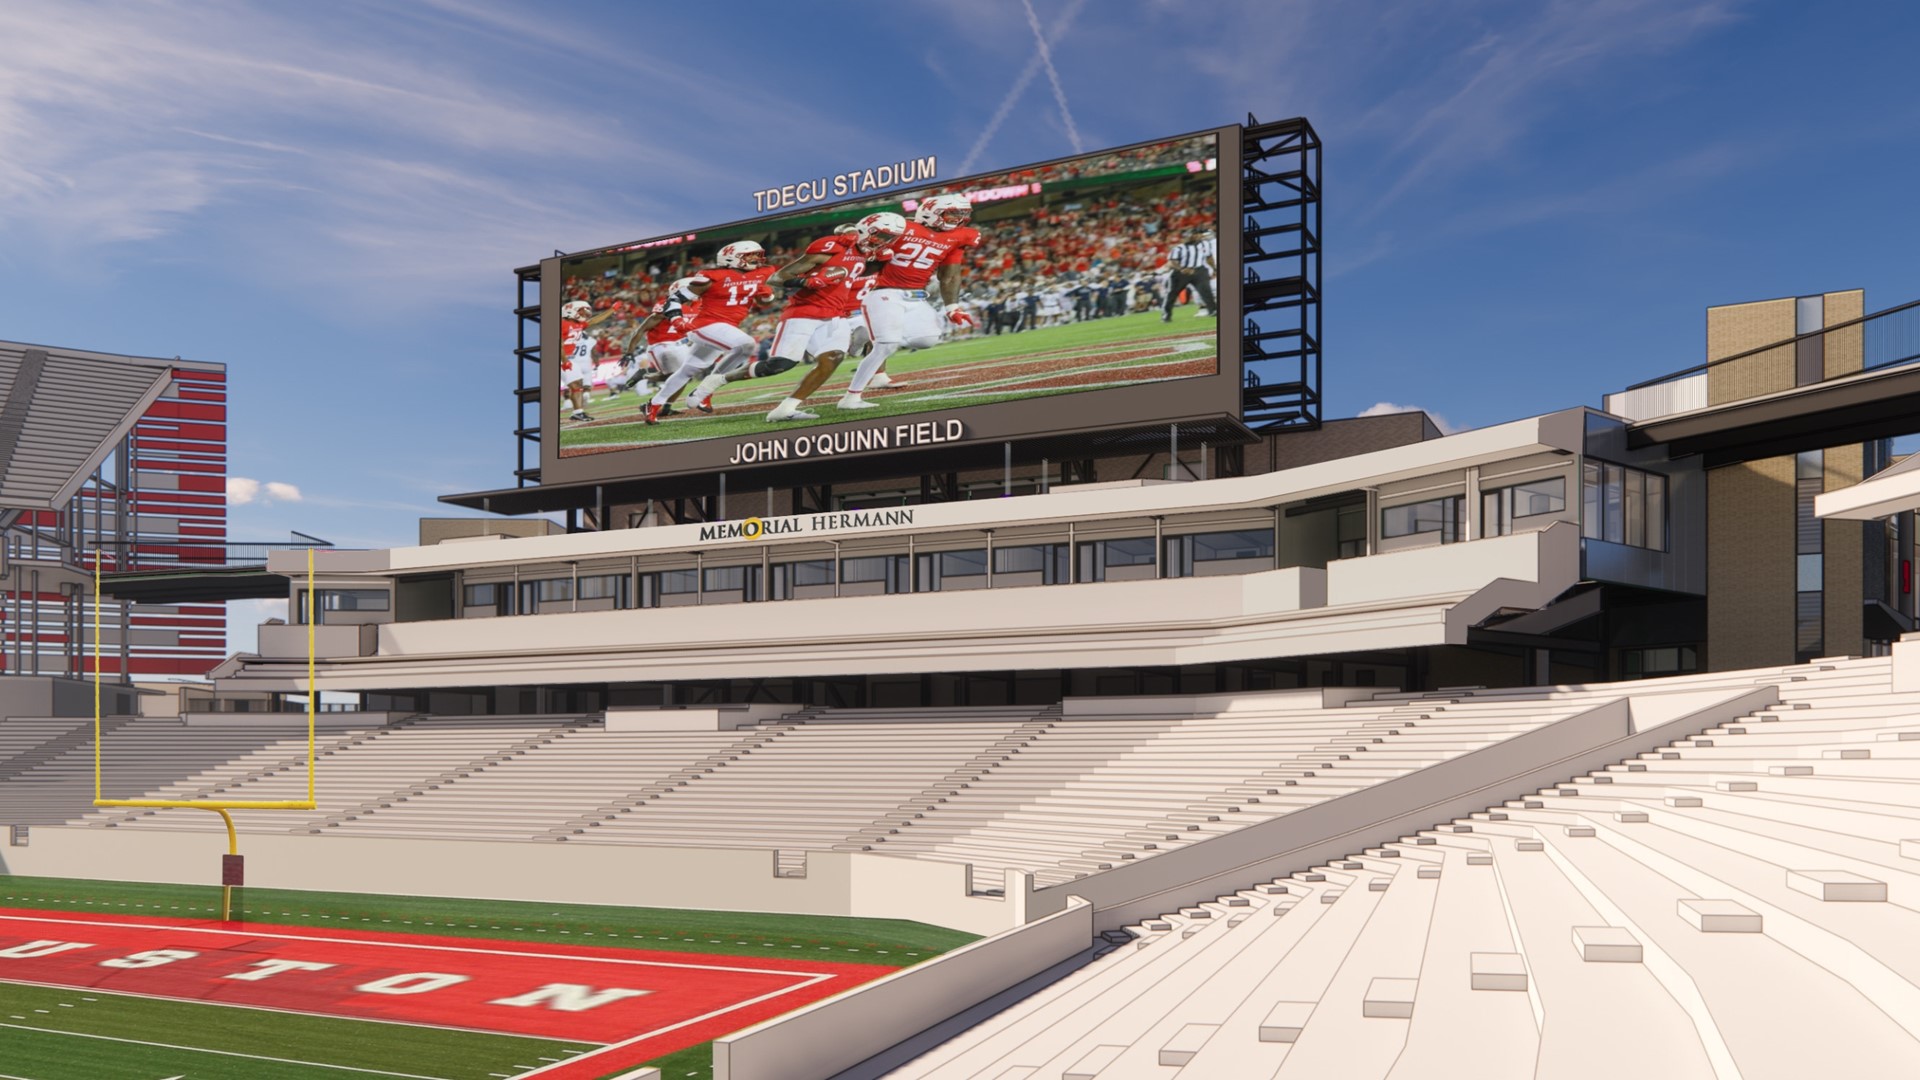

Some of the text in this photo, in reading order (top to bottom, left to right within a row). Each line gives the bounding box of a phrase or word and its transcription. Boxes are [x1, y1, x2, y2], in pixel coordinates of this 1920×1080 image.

[753, 155, 937, 212] TDECU STADIUM
[821, 241, 836, 252] 9
[889, 242, 943, 270] 25
[902, 235, 951, 250] HOUSTON
[726, 284, 758, 306] 17
[729, 418, 963, 464] JOHN O'QUINN FIELD
[699, 509, 914, 541] MEMORIAL HERMANN
